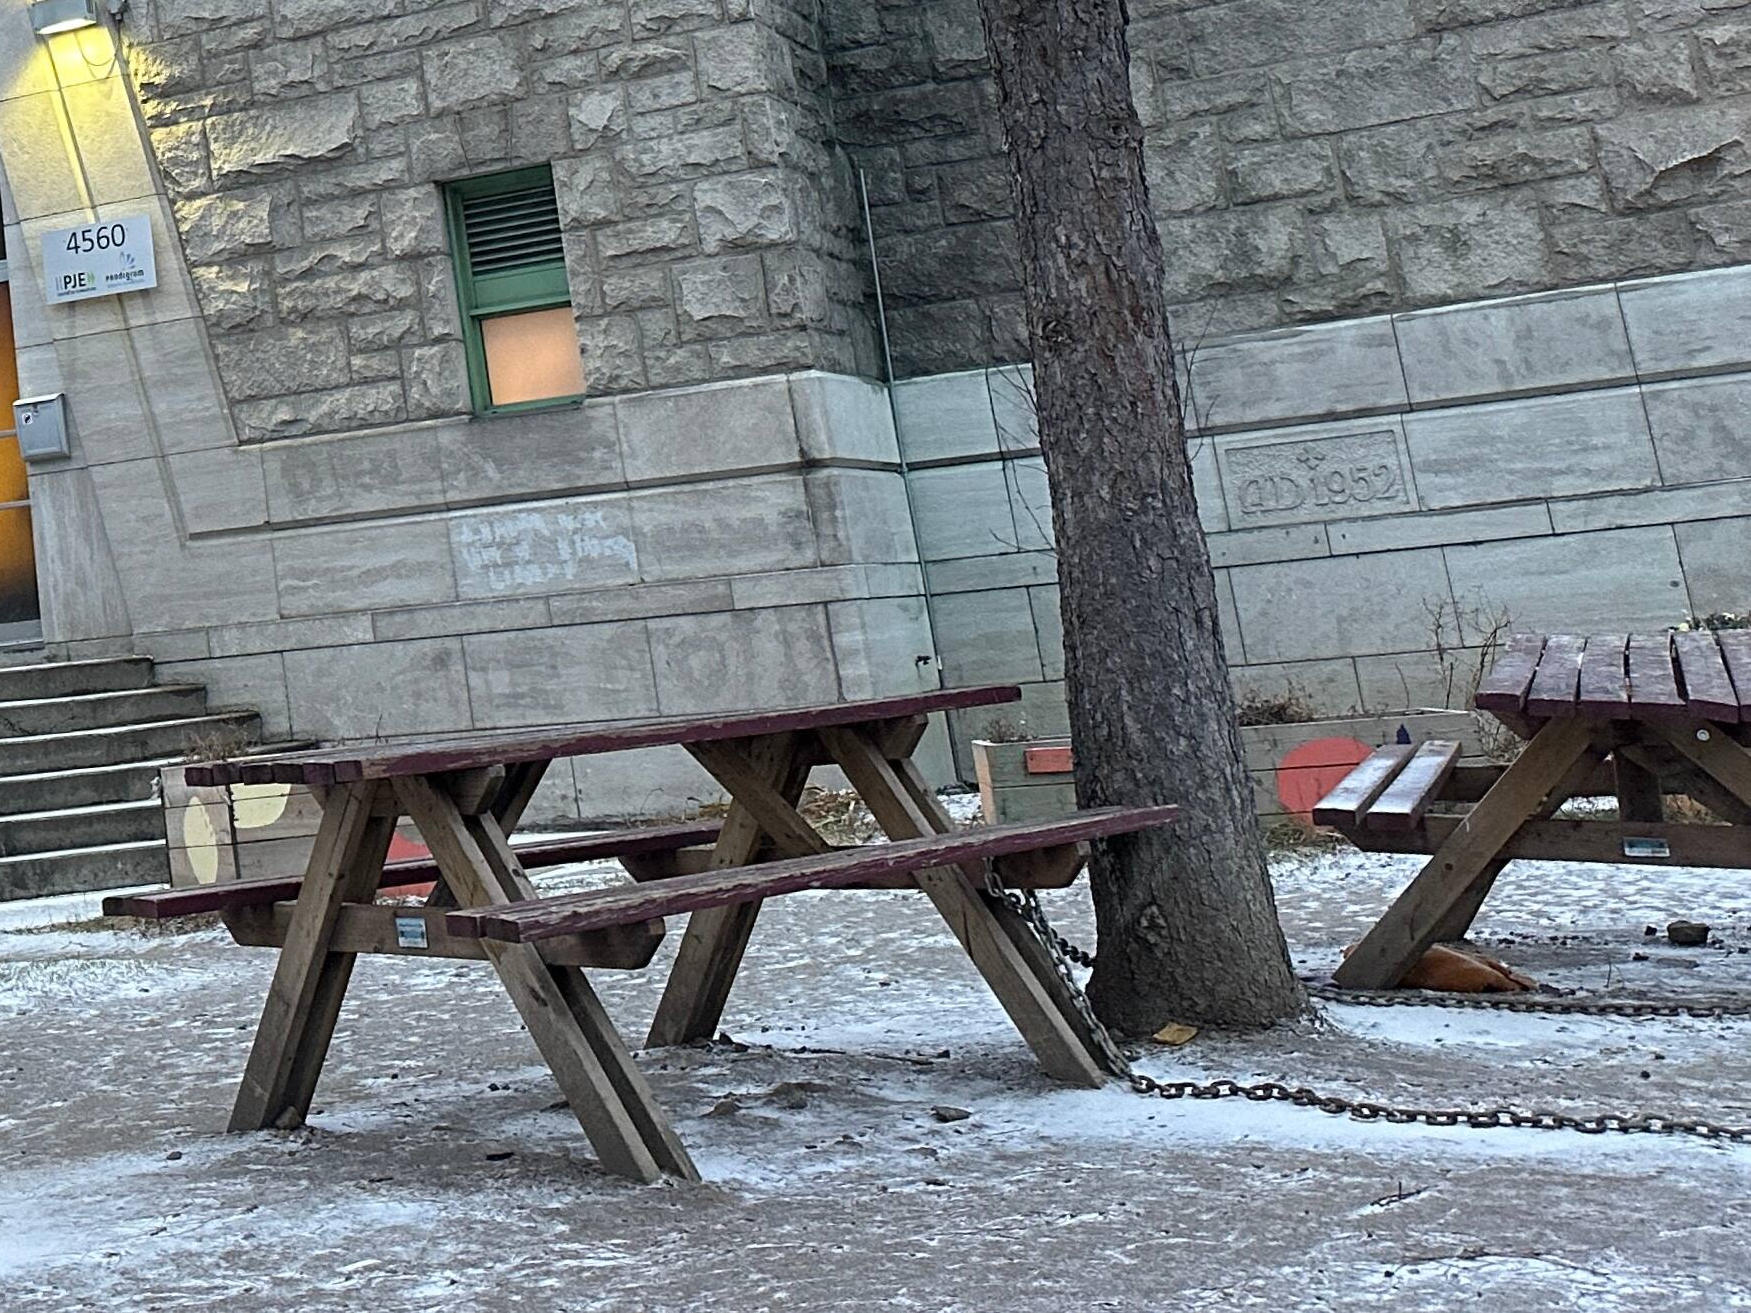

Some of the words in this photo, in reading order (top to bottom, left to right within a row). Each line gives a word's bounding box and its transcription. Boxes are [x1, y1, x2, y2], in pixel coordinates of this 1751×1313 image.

[66, 223, 126, 255] 4560
[63, 272, 87, 291] PJE
[1310, 464, 1399, 507] 1952
